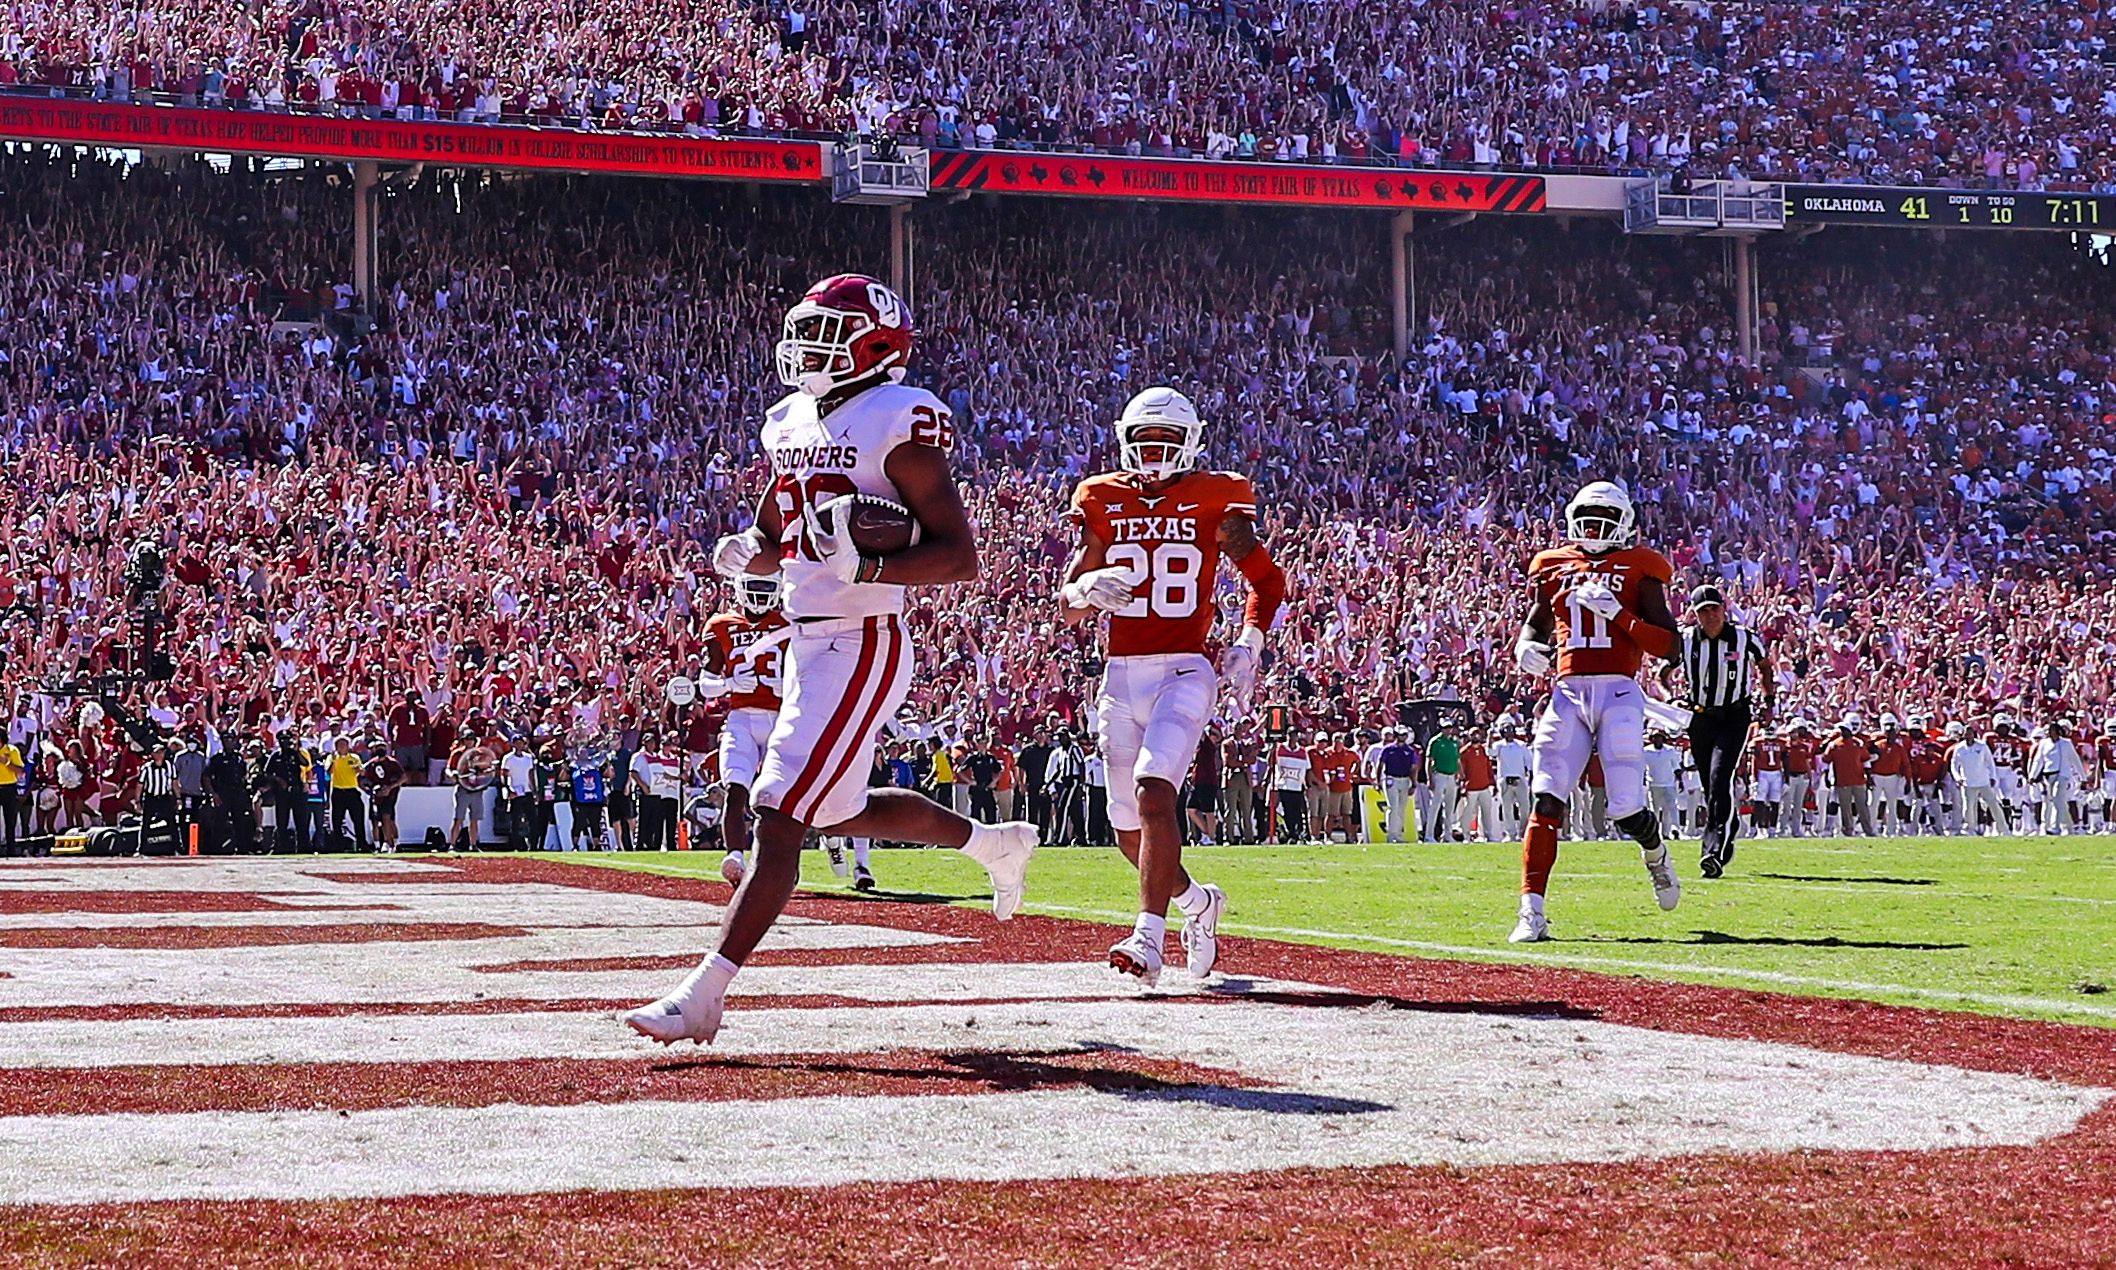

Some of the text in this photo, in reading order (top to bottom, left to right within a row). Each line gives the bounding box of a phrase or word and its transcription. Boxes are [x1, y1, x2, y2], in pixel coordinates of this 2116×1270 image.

[39, 109, 54, 127] TO
[58, 110, 82, 129] THE
[87, 112, 119, 132] STATE
[127, 114, 152, 134] FAIR
[176, 118, 213, 137] TEXAS
[217, 120, 245, 139] HAVE
[251, 122, 293, 143] HELPED
[299, 125, 346, 146] PROVIDE
[351, 129, 383, 149] MORE
[388, 131, 418, 150] THAN
[423, 133, 454, 152] $15
[458, 136, 503, 155] MILLION
[508, 138, 521, 156] IN
[525, 139, 573, 159] COLLEGE
[576, 142, 658, 163] SCHOLARSHIPS
[663, 147, 677, 164] TO
[681, 148, 717, 167] TEXAS
[1122, 168, 1360, 198] WELCOME TO THE STATE FAIR OF TEXAS
[1804, 197, 1886, 212] OKLAHOMA
[1899, 197, 1930, 219] 41
[1948, 195, 1979, 204] DOWN
[1987, 196, 2000, 205] TO
[2046, 199, 2099, 224] 7:11
[1959, 206, 2012, 223] 1 10
[776, 445, 858, 470] SOONERS
[1111, 517, 1196, 542] TEXAS
[1106, 543, 1203, 618] 28
[1565, 591, 1612, 648] 11
[729, 644, 783, 692] 23
[408, 710, 416, 725] 1
[1767, 751, 1777, 766] 1
[1992, 748, 2012, 763] 44
